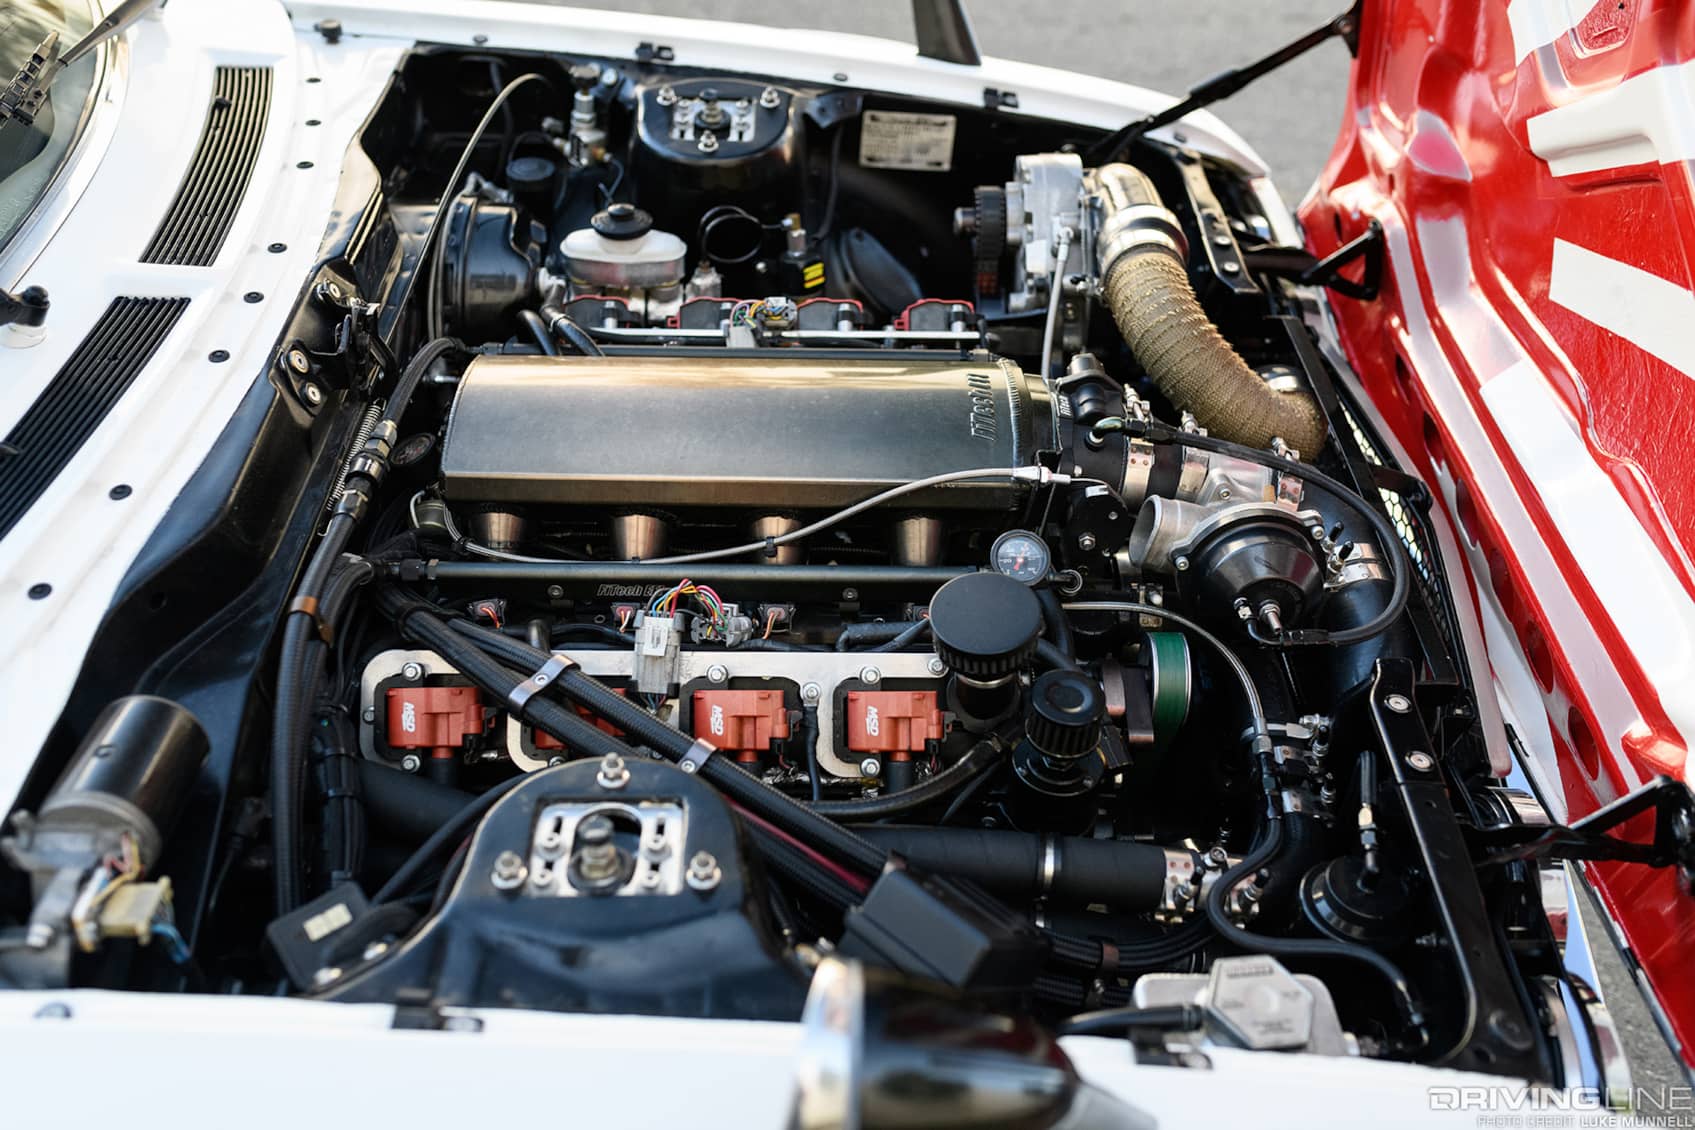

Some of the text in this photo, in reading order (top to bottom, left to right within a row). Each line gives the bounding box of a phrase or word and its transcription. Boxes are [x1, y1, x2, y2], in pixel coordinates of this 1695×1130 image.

[402, 702, 416, 732] MSD
[710, 705, 724, 736] MSD
[865, 706, 879, 736] MSD
